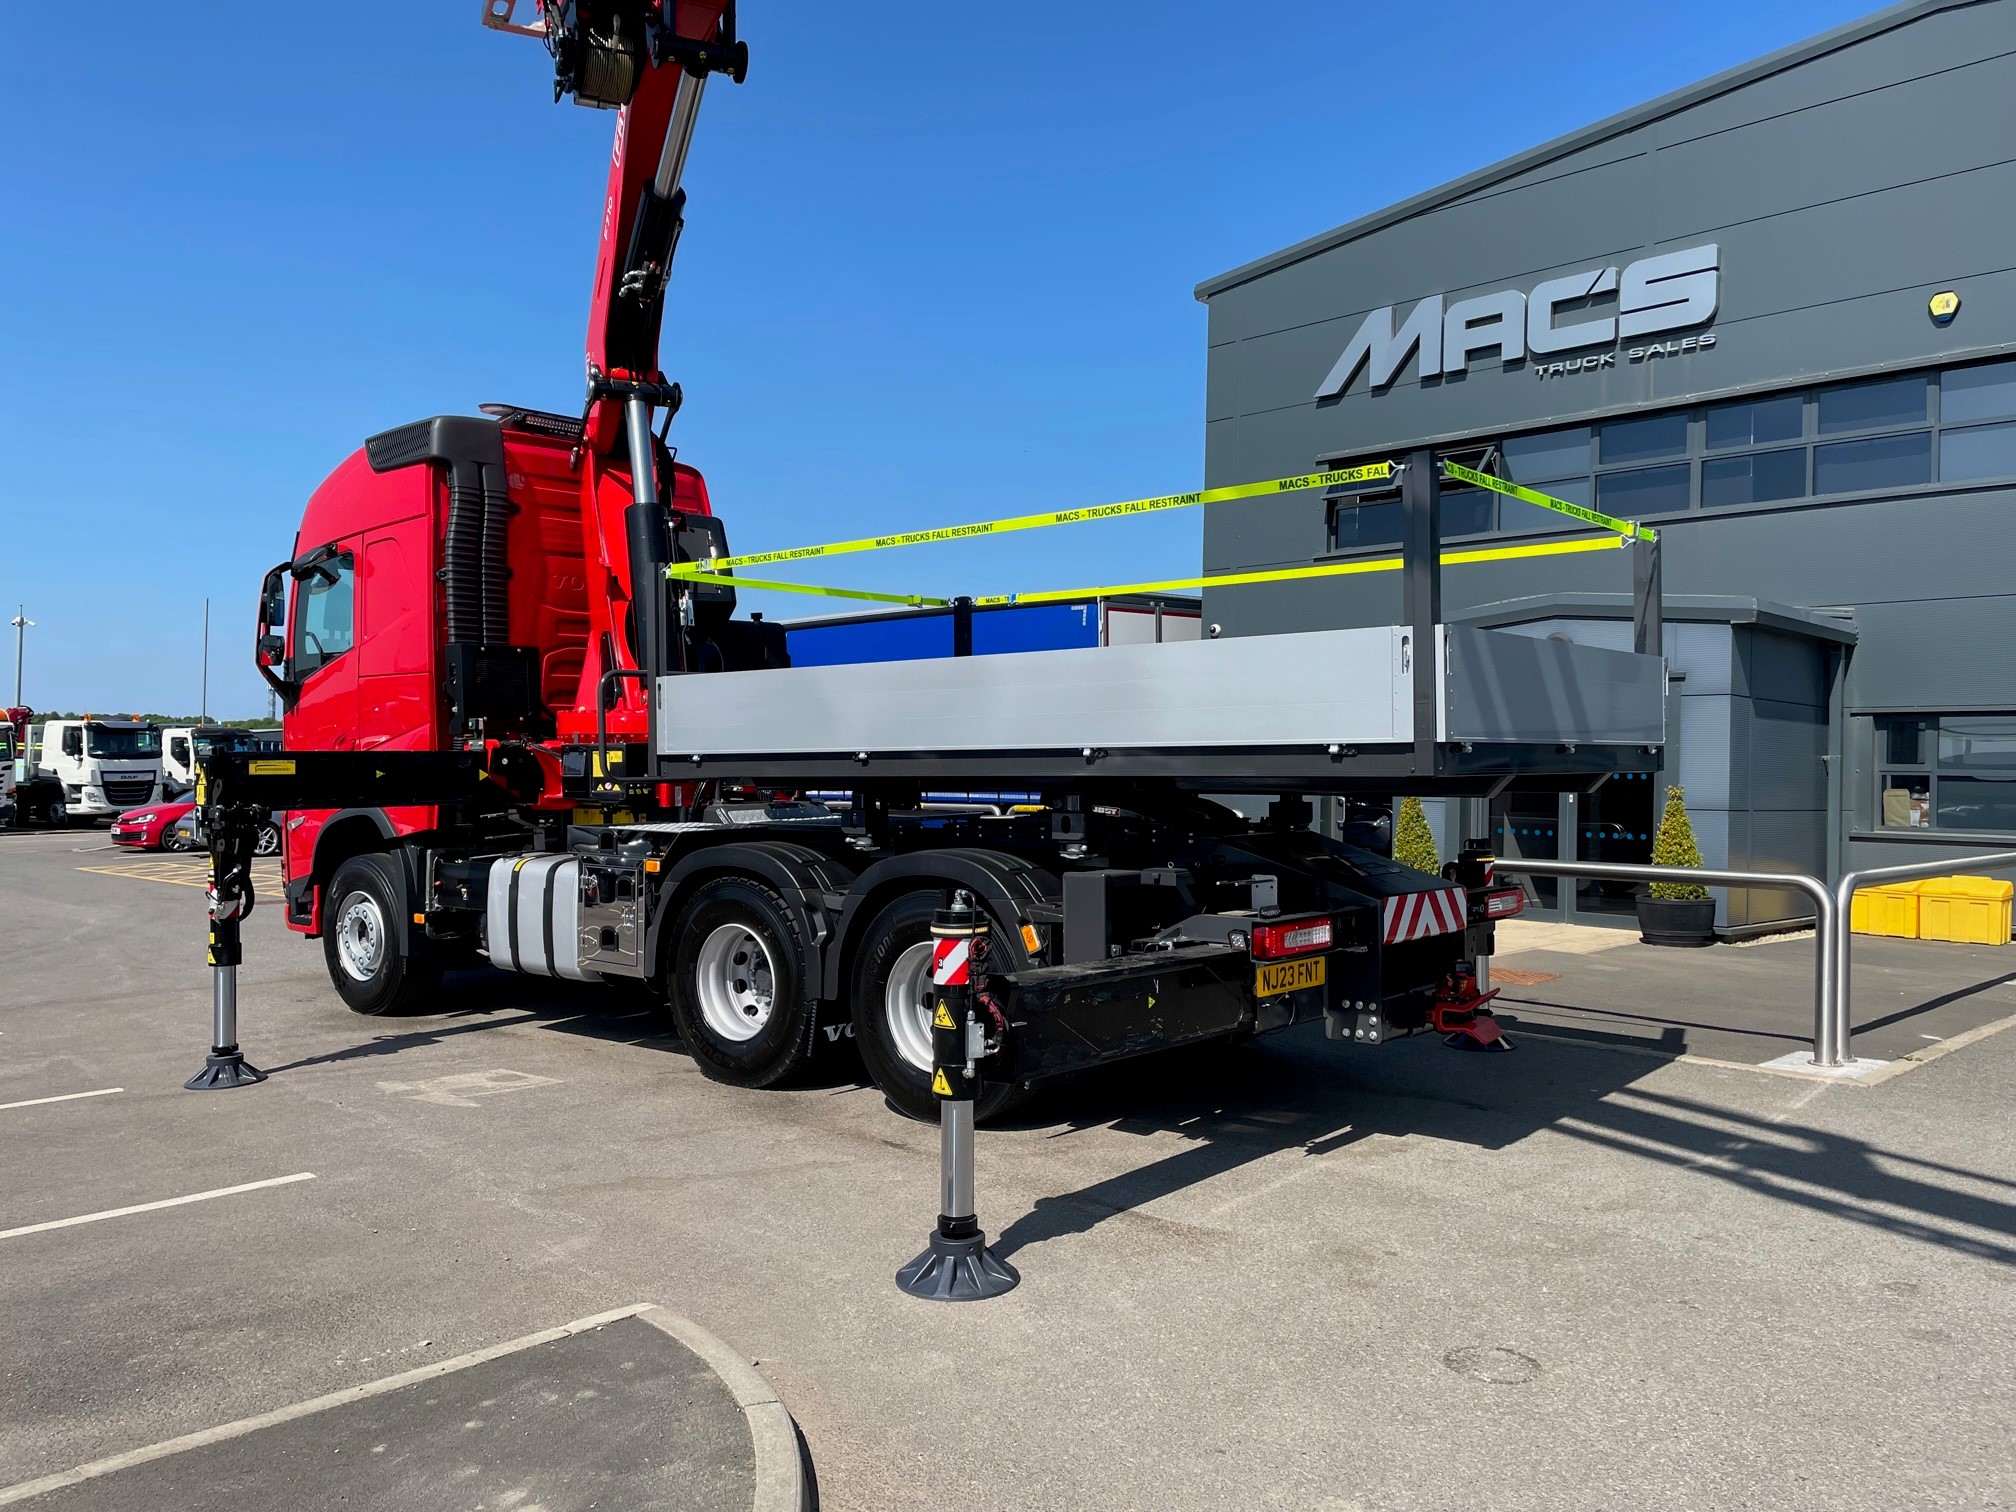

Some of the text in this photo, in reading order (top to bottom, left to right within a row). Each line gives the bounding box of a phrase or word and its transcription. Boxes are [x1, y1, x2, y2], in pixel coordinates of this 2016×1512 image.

[1535, 334, 1717, 376] TRUCK SALES
[1279, 477, 1309, 491] MACS
[1318, 468, 1363, 484] TRUCKS
[1458, 467, 1478, 482] TRUCKS
[1480, 475, 1491, 487] FALL
[1492, 479, 1518, 495] RESTRAINT
[1055, 511, 1080, 523] MACS
[1087, 505, 1122, 518] TRUCKS
[1125, 502, 1147, 513] FALL
[1149, 493, 1201, 509] RESTRAINT
[1550, 499, 1562, 510] MACS
[1565, 504, 1581, 517] TRUCKS
[1582, 510, 1591, 520] FALL
[1591, 513, 1612, 526] RESTRAINT
[875, 537, 896, 547] MACS
[901, 533, 930, 544] TRUCKS
[932, 530, 950, 540] FALL
[951, 523, 994, 537] RESTRAINT
[726, 557, 743, 566] MACS
[748, 554, 772, 564] TRUCKS
[773, 551, 789, 561] FALL
[789, 546, 825, 558] RESTRAINT
[985, 596, 1000, 604] MACS
[938, 959, 943, 967] 3
[1262, 960, 1320, 992] NJ23 FNT
